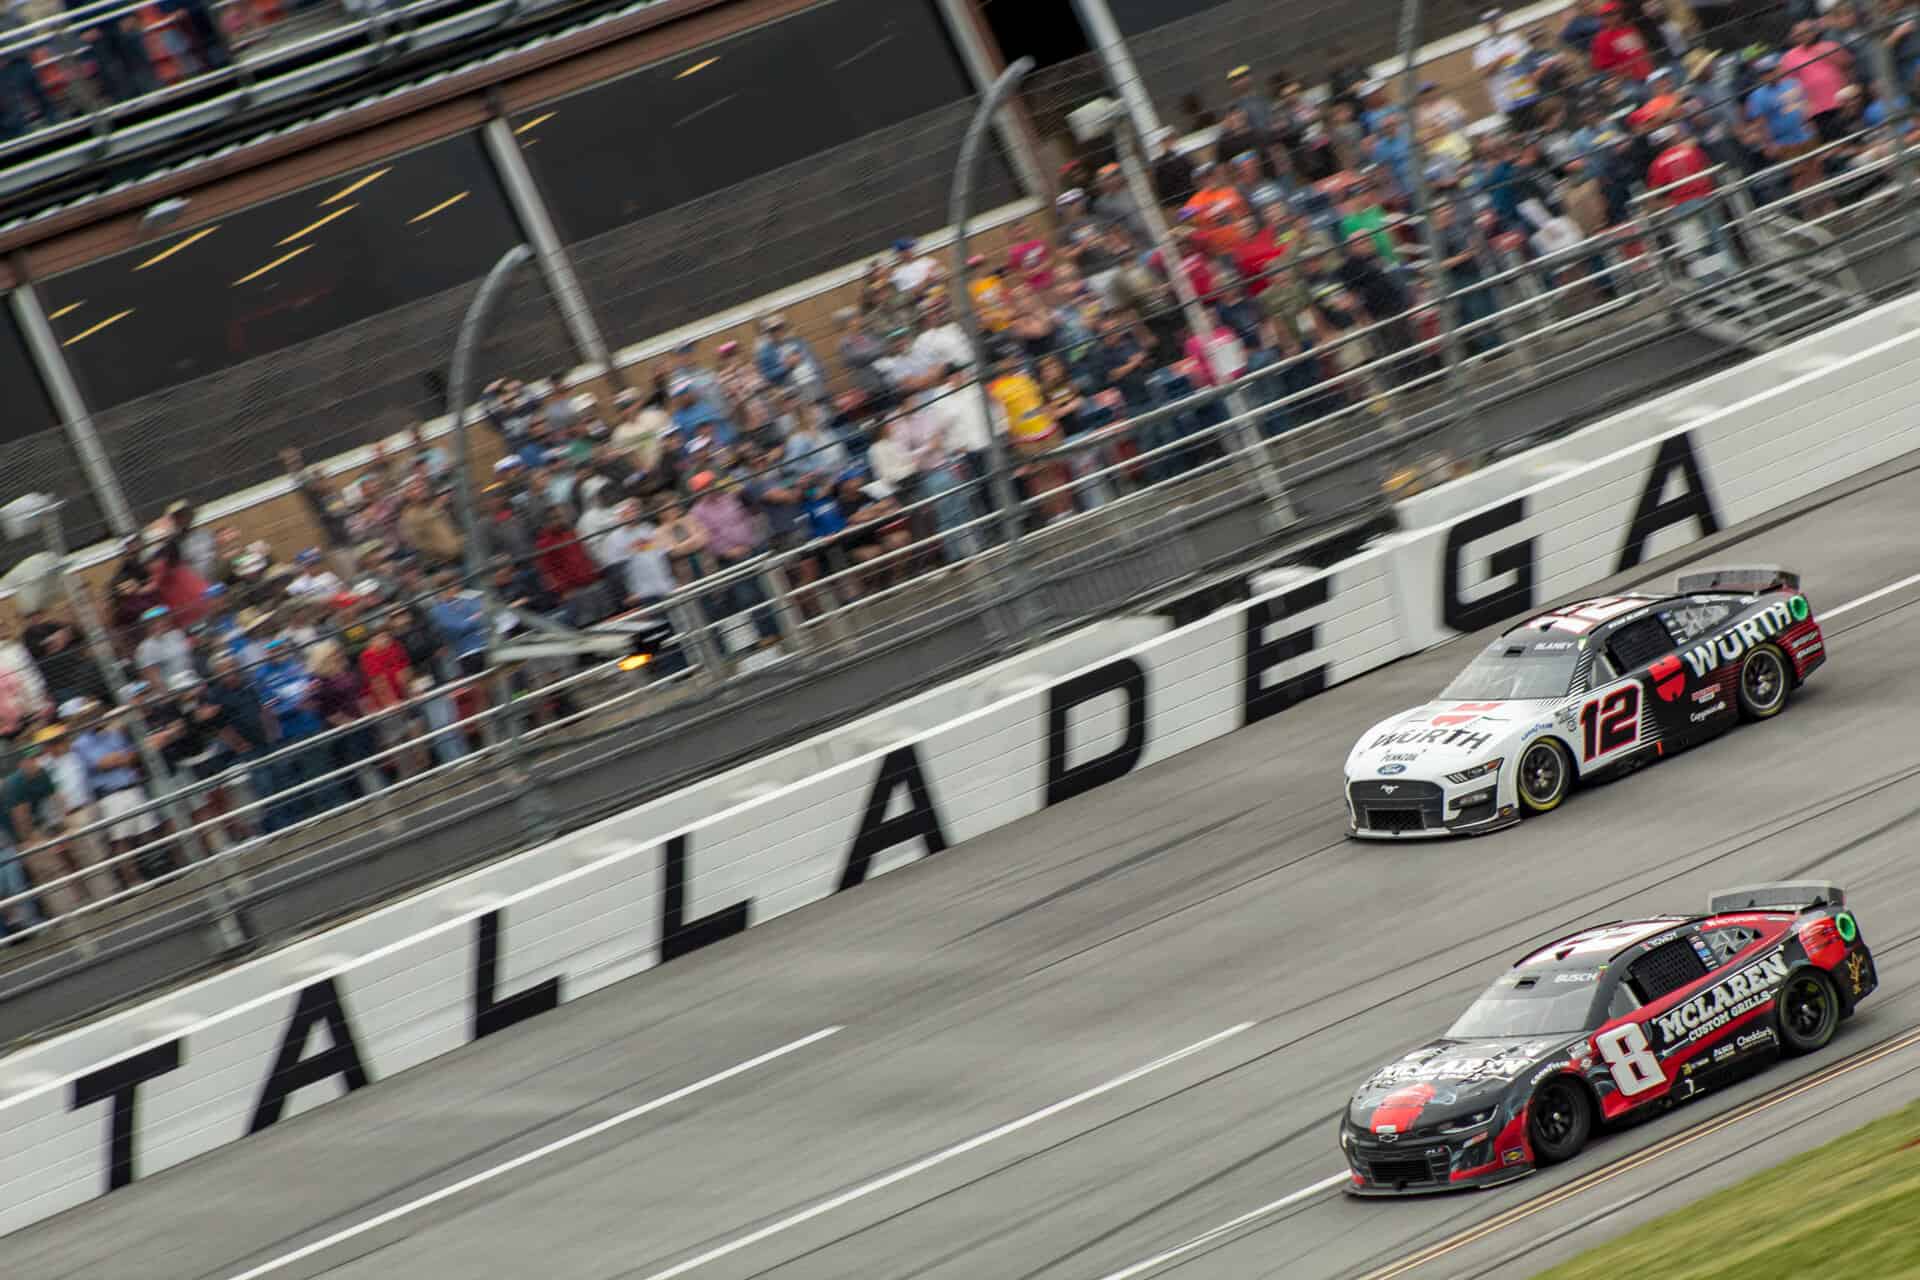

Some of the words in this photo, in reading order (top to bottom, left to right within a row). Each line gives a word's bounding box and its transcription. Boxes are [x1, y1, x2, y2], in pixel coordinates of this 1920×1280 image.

[1580, 684, 1640, 763] 12
[67, 430, 1722, 1191] TALLADEGA
[1658, 953, 1790, 1042] MCLAREN
[1688, 1012, 1730, 1041] CUSTOM
[1730, 991, 1772, 1017] GRILLS
[1596, 1022, 1667, 1096] 8
